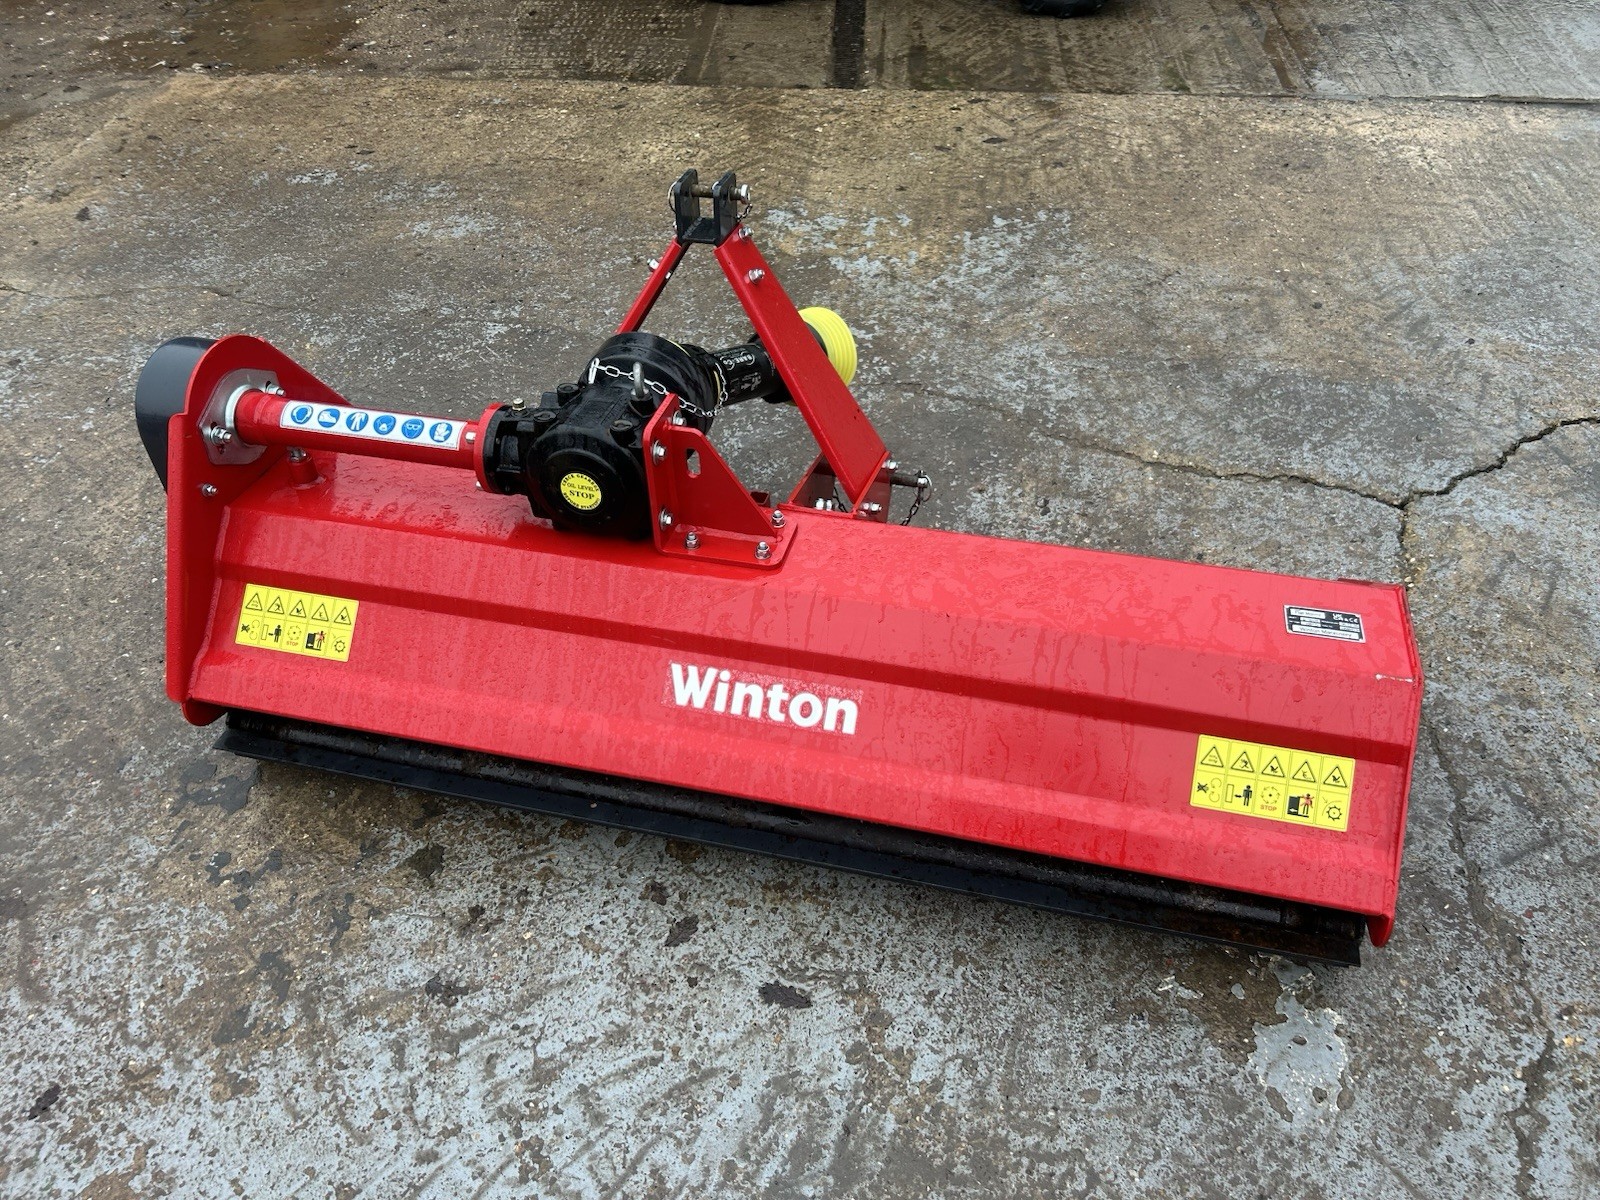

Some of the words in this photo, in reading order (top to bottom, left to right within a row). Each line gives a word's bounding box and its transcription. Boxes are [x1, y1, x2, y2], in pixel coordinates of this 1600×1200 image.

[577, 484, 596, 492] LEVEL
[569, 489, 595, 500] STOP
[1299, 626, 1320, 635] Winton
[671, 663, 858, 735] Winton
[1259, 803, 1277, 812] STOP
